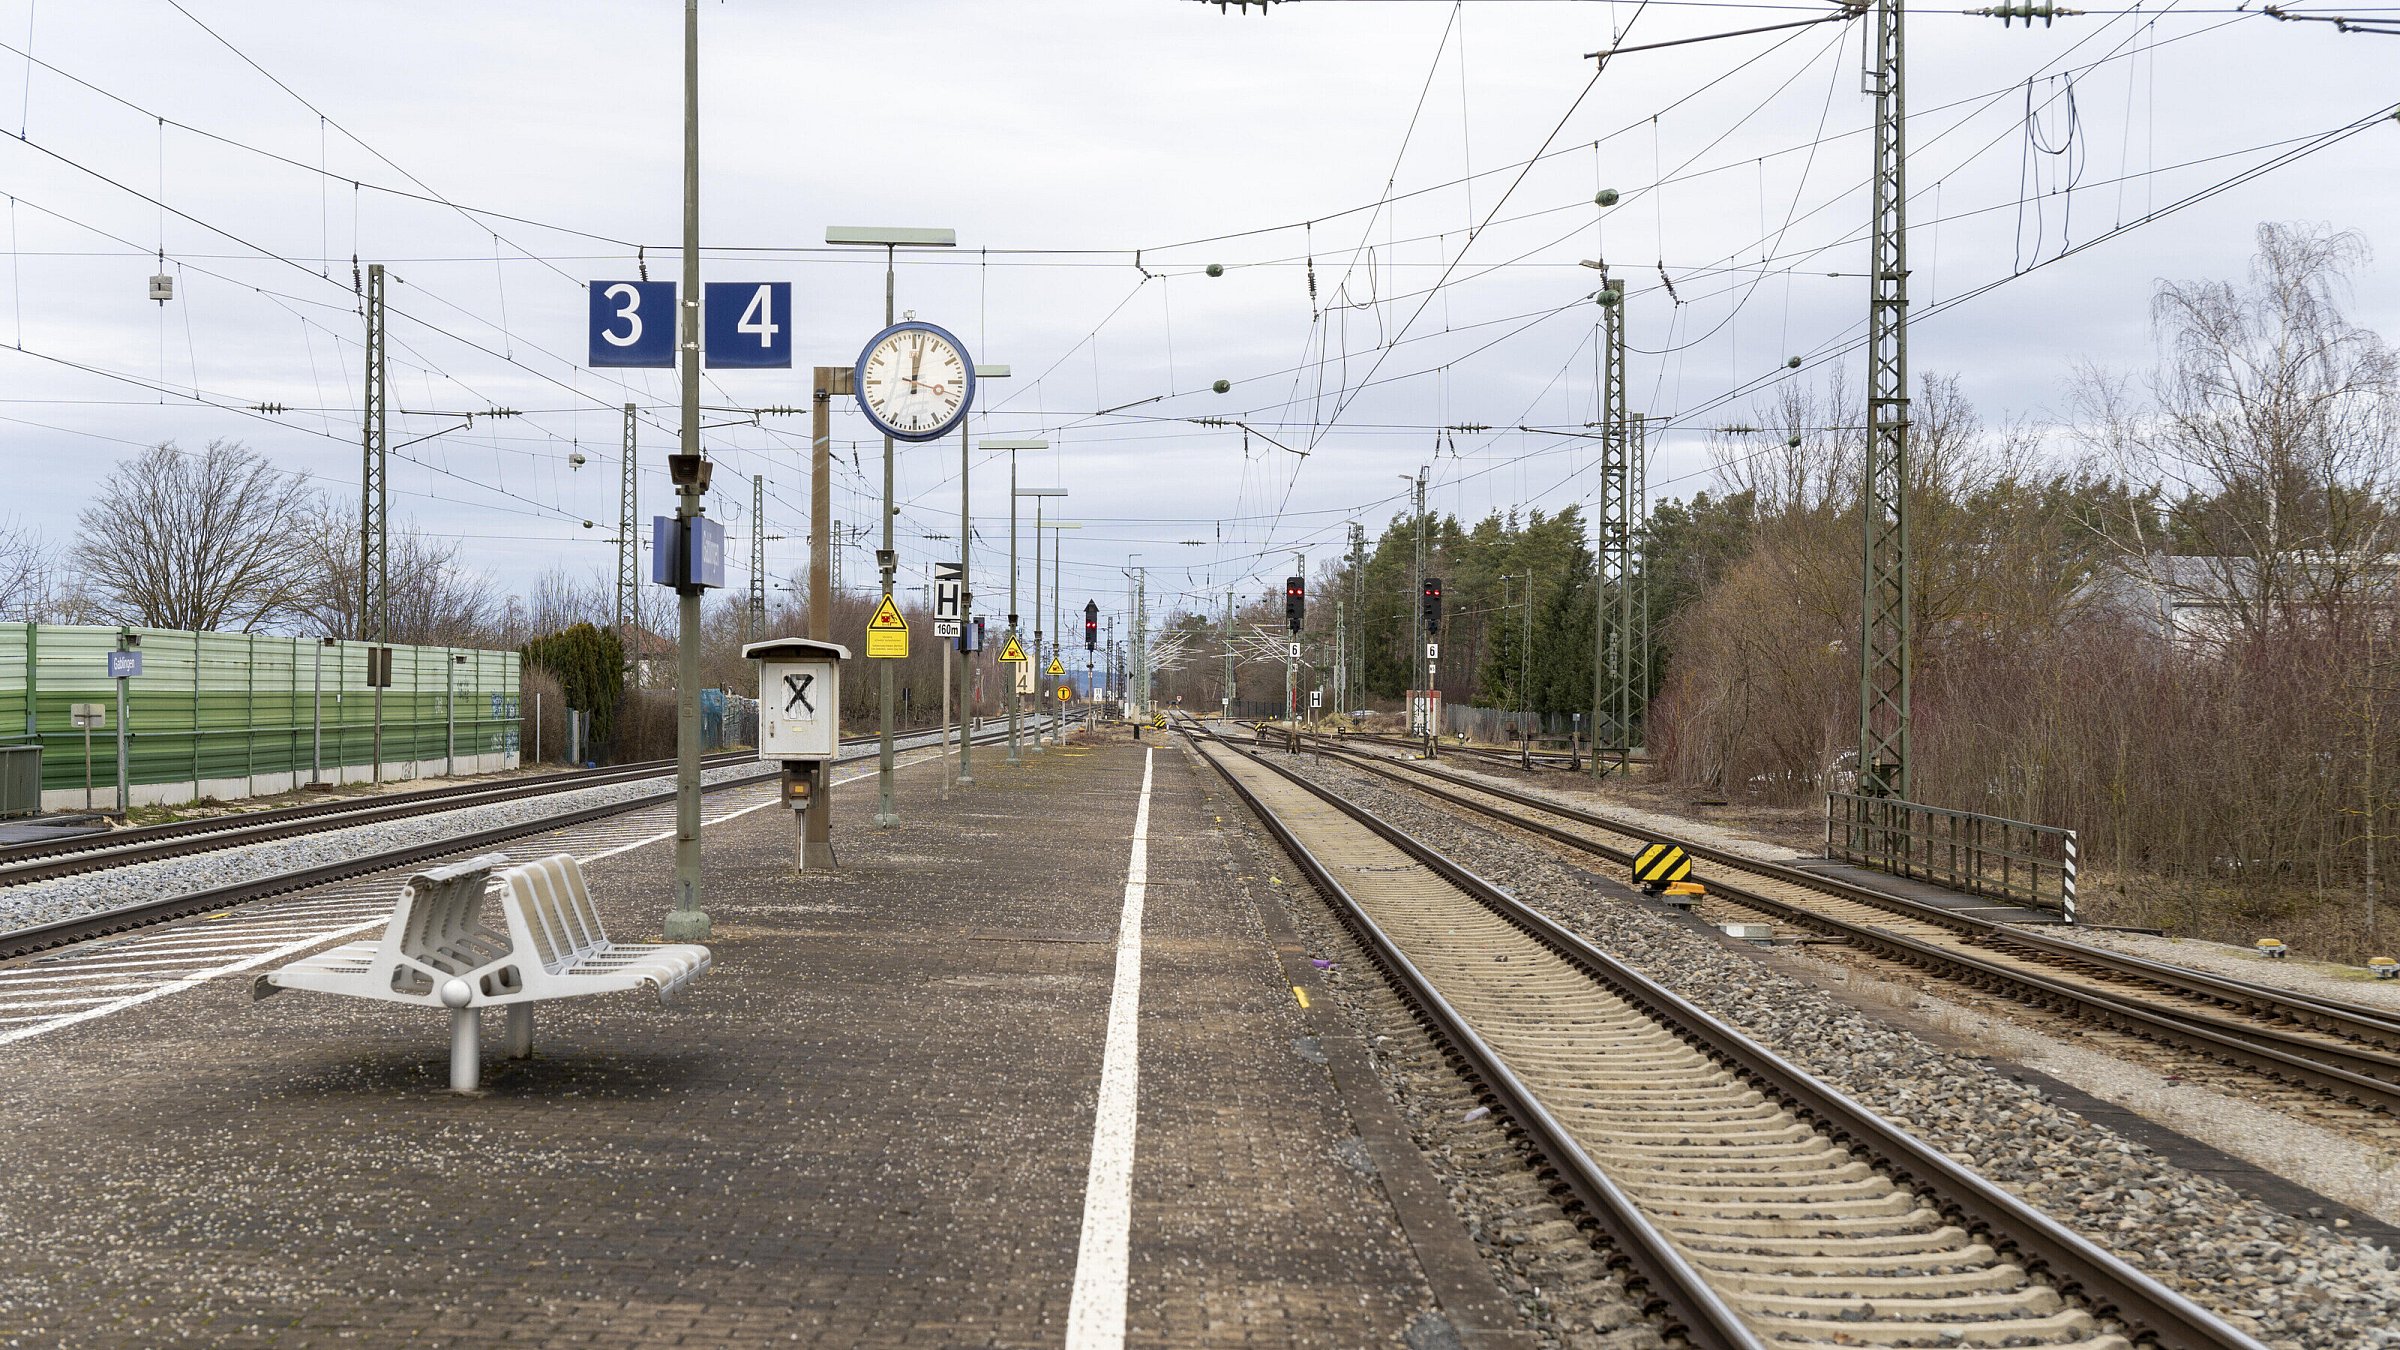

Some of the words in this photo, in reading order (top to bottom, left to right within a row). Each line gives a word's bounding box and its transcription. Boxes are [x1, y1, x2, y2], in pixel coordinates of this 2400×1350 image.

[601, 283, 643, 347] 3
[737, 284, 779, 348] 4
[937, 583, 959, 616] H
[937, 624, 959, 635] 160m
[1292, 644, 1298, 655] 6
[1430, 646, 1435, 656] 6
[113, 656, 136, 672] Gablingen
[1016, 674, 1028, 690] 4
[1311, 692, 1321, 706] H
